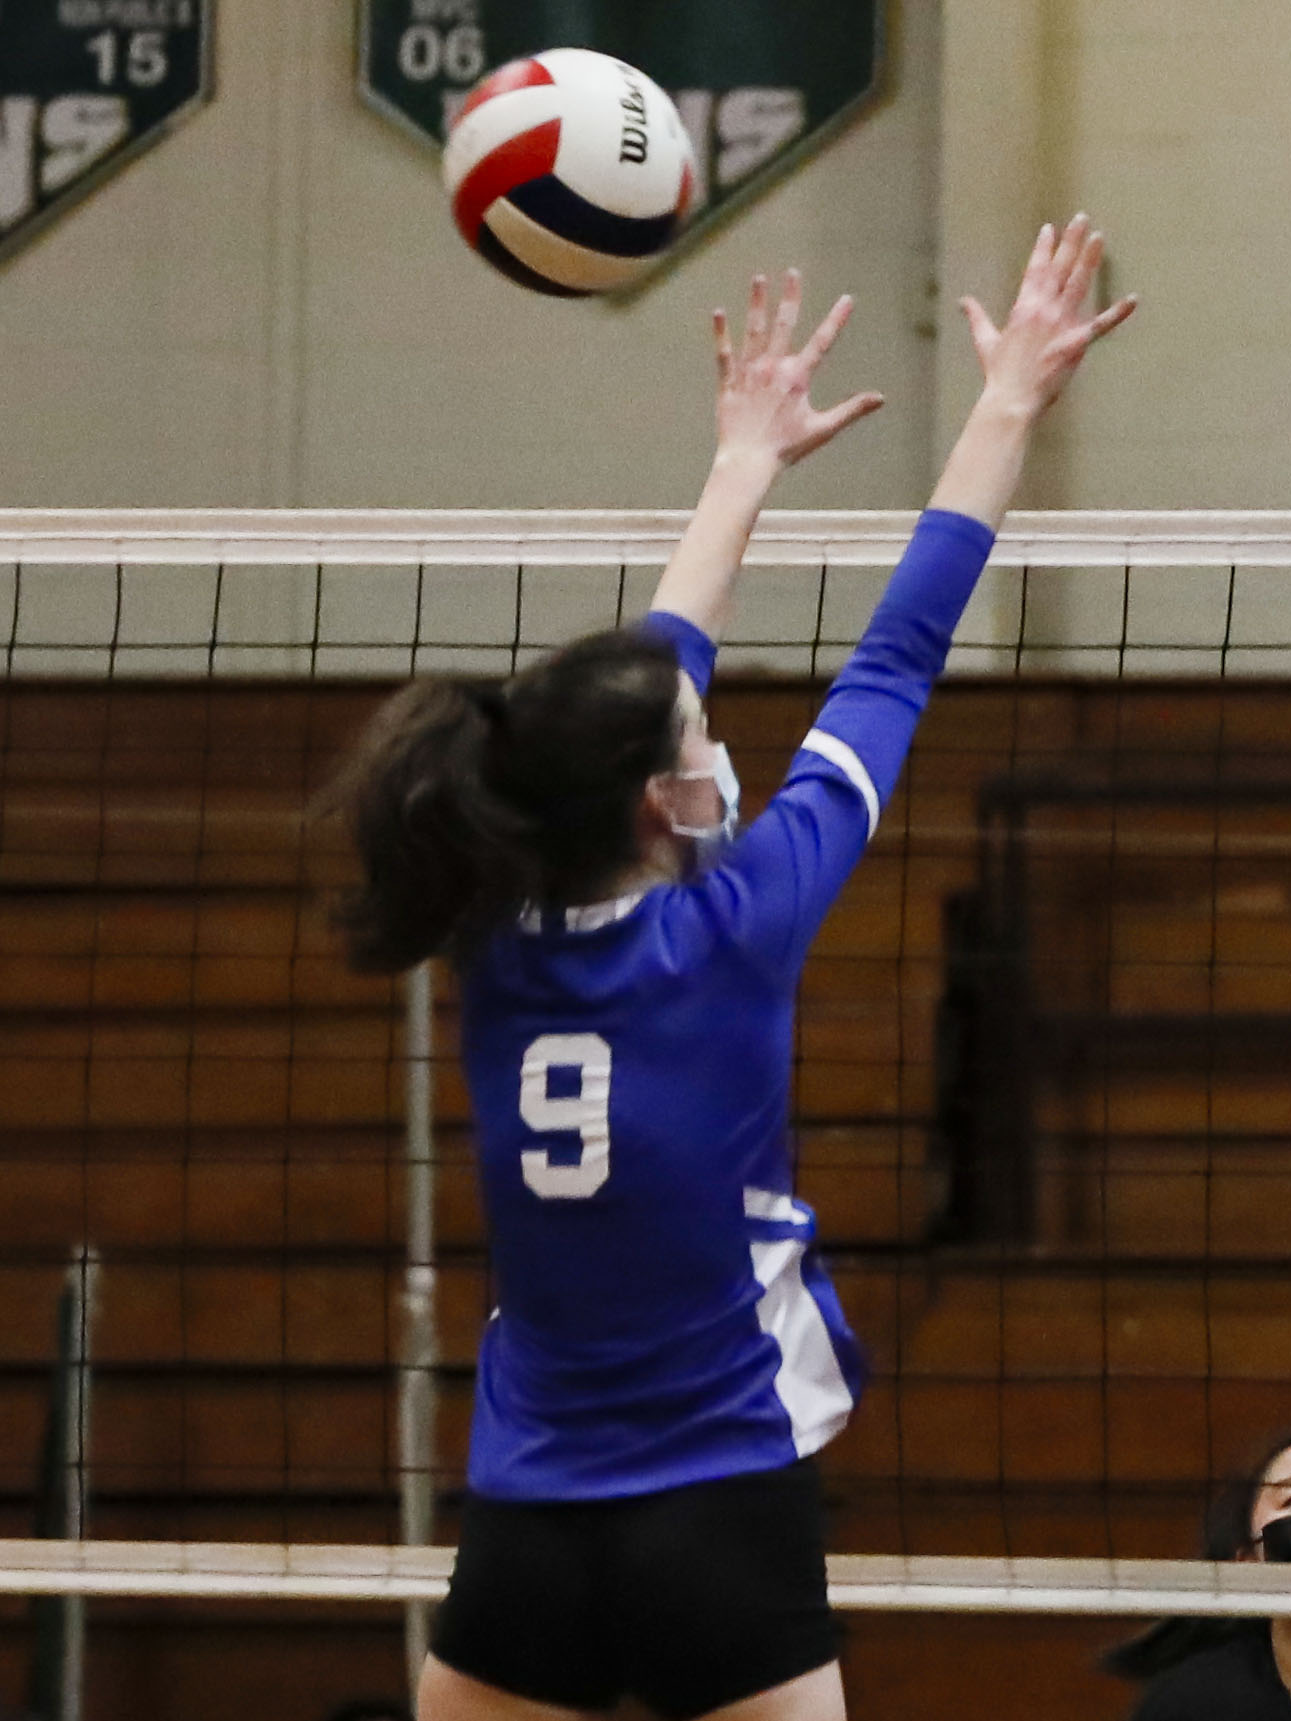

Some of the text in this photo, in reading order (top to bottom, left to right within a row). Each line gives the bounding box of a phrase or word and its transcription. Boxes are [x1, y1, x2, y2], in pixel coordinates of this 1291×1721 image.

[86, 29, 168, 87] 15
[399, 25, 483, 82] 06
[617, 63, 647, 164] Wils
[519, 1032, 612, 1199] 9
